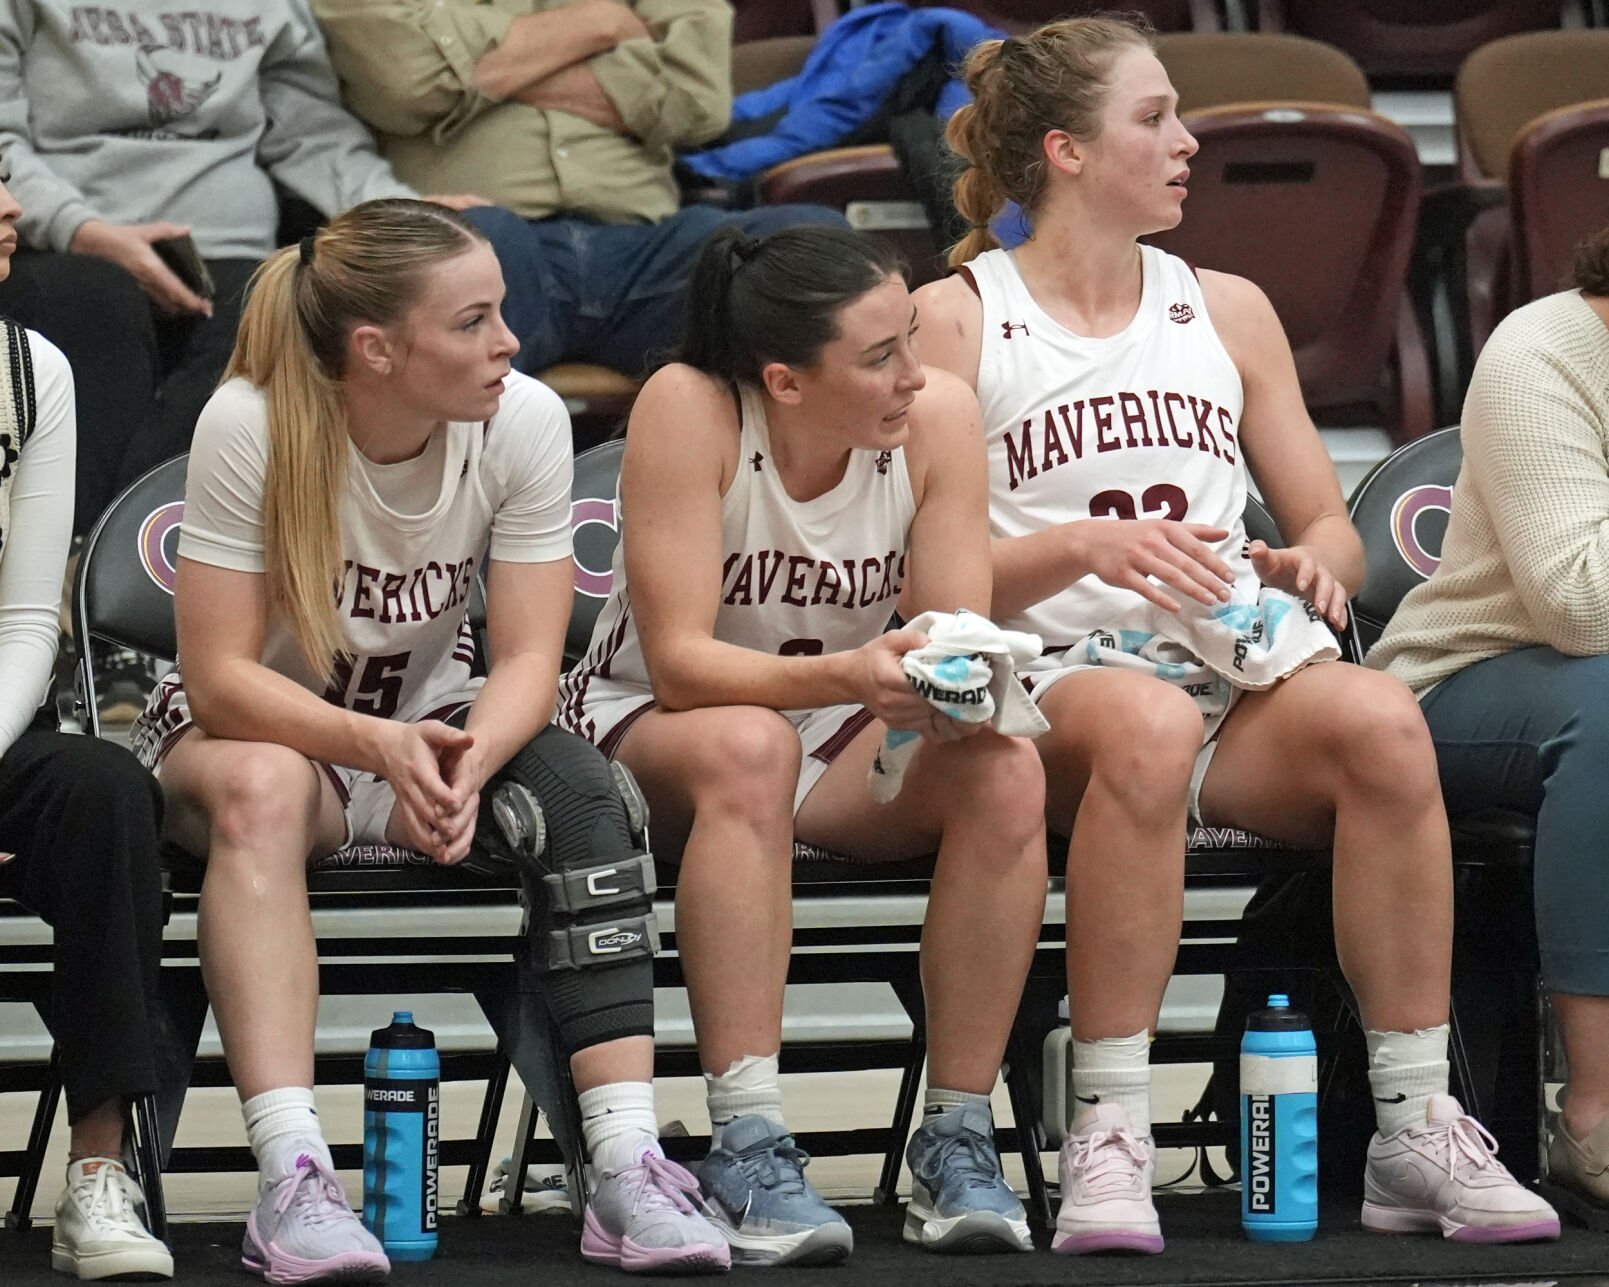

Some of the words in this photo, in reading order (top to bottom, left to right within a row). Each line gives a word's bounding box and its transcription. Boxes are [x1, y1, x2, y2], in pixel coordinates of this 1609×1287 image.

[1003, 390, 1236, 491] MAVERICKS
[333, 557, 473, 624] VERICKS
[910, 675, 987, 705] WERAD
[426, 1087, 439, 1230] POWERADE
[1252, 1095, 1270, 1211] POWERA
